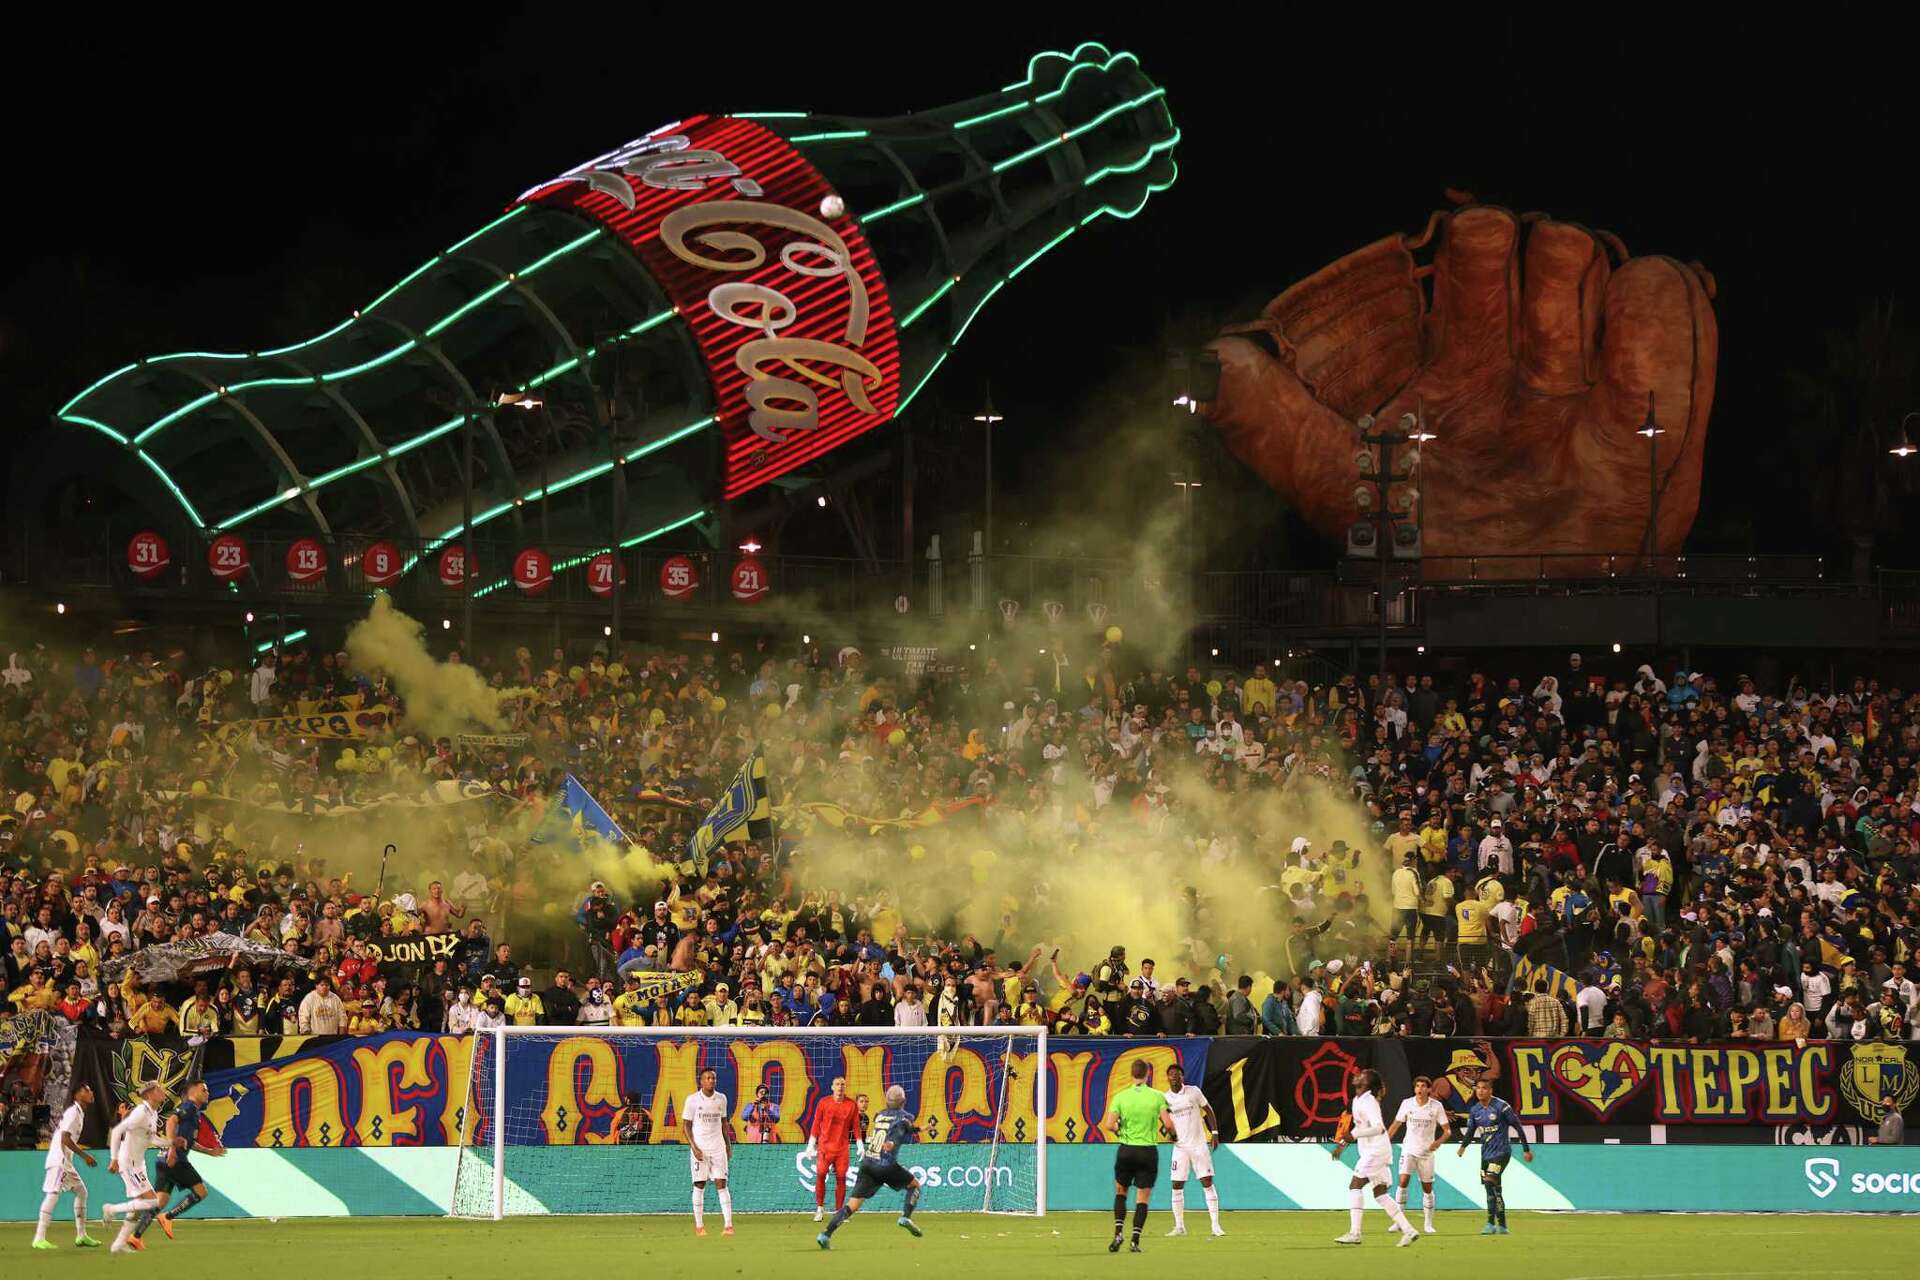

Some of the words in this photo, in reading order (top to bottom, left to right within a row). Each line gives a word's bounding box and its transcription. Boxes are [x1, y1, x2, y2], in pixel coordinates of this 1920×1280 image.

[136, 543, 159, 563] 31
[217, 546, 241, 566] 23
[298, 551, 318, 572] 13
[376, 553, 388, 572] 9
[526, 560, 538, 578] 5
[668, 567, 689, 586] 35
[739, 570, 760, 589] 21
[383, 941, 426, 962] JON
[1855, 1056, 1874, 1064] NOR
[1861, 1066, 1873, 1083] L
[694, 1161, 700, 1172] 3
[845, 1165, 1013, 1187] sos.com
[135, 1173, 147, 1184] 15
